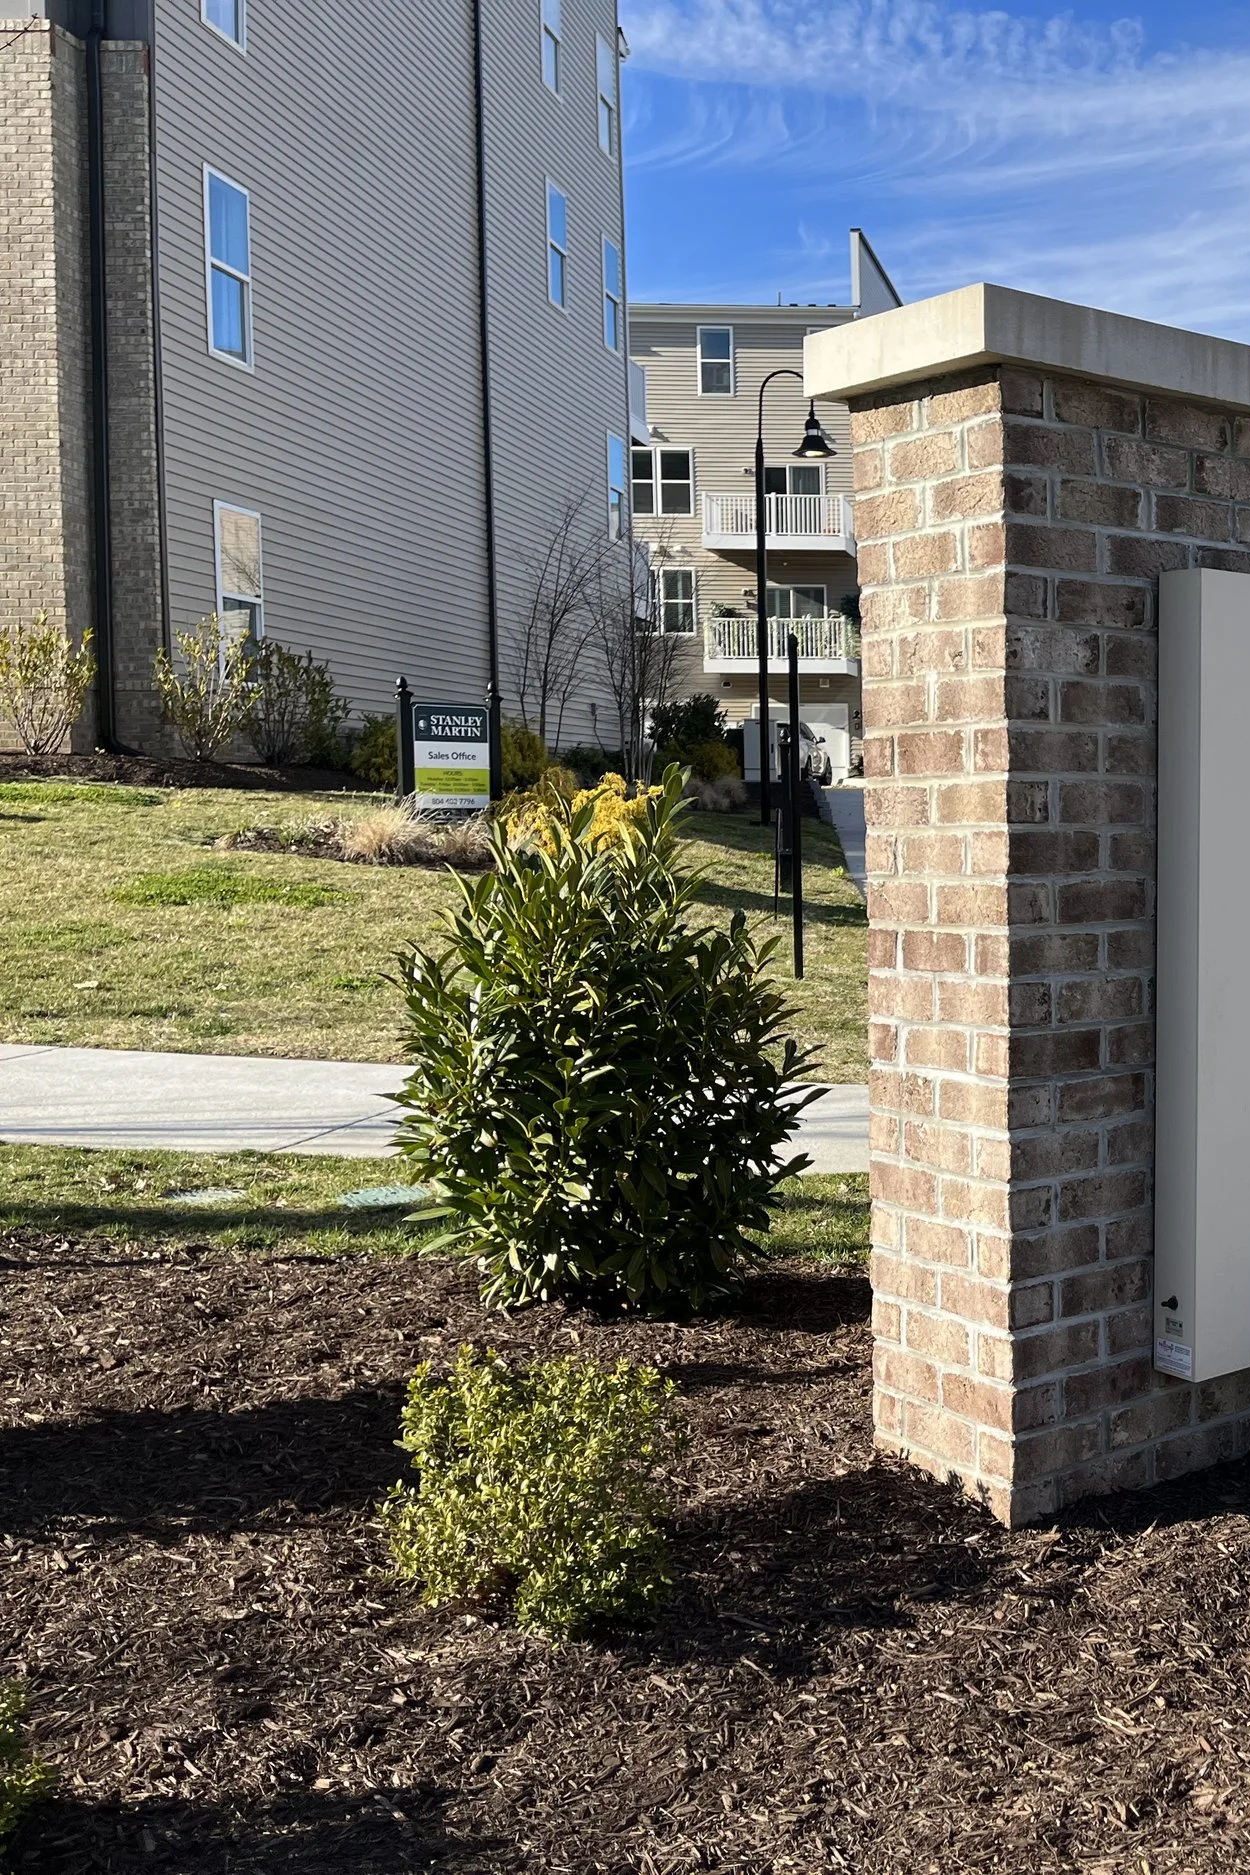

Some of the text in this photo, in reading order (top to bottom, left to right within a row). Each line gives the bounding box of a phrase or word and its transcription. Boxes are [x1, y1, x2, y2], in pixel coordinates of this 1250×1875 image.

[430, 714, 483, 727] STANLEY
[430, 726, 481, 737] MARTIN
[428, 751, 477, 761] Sales Office
